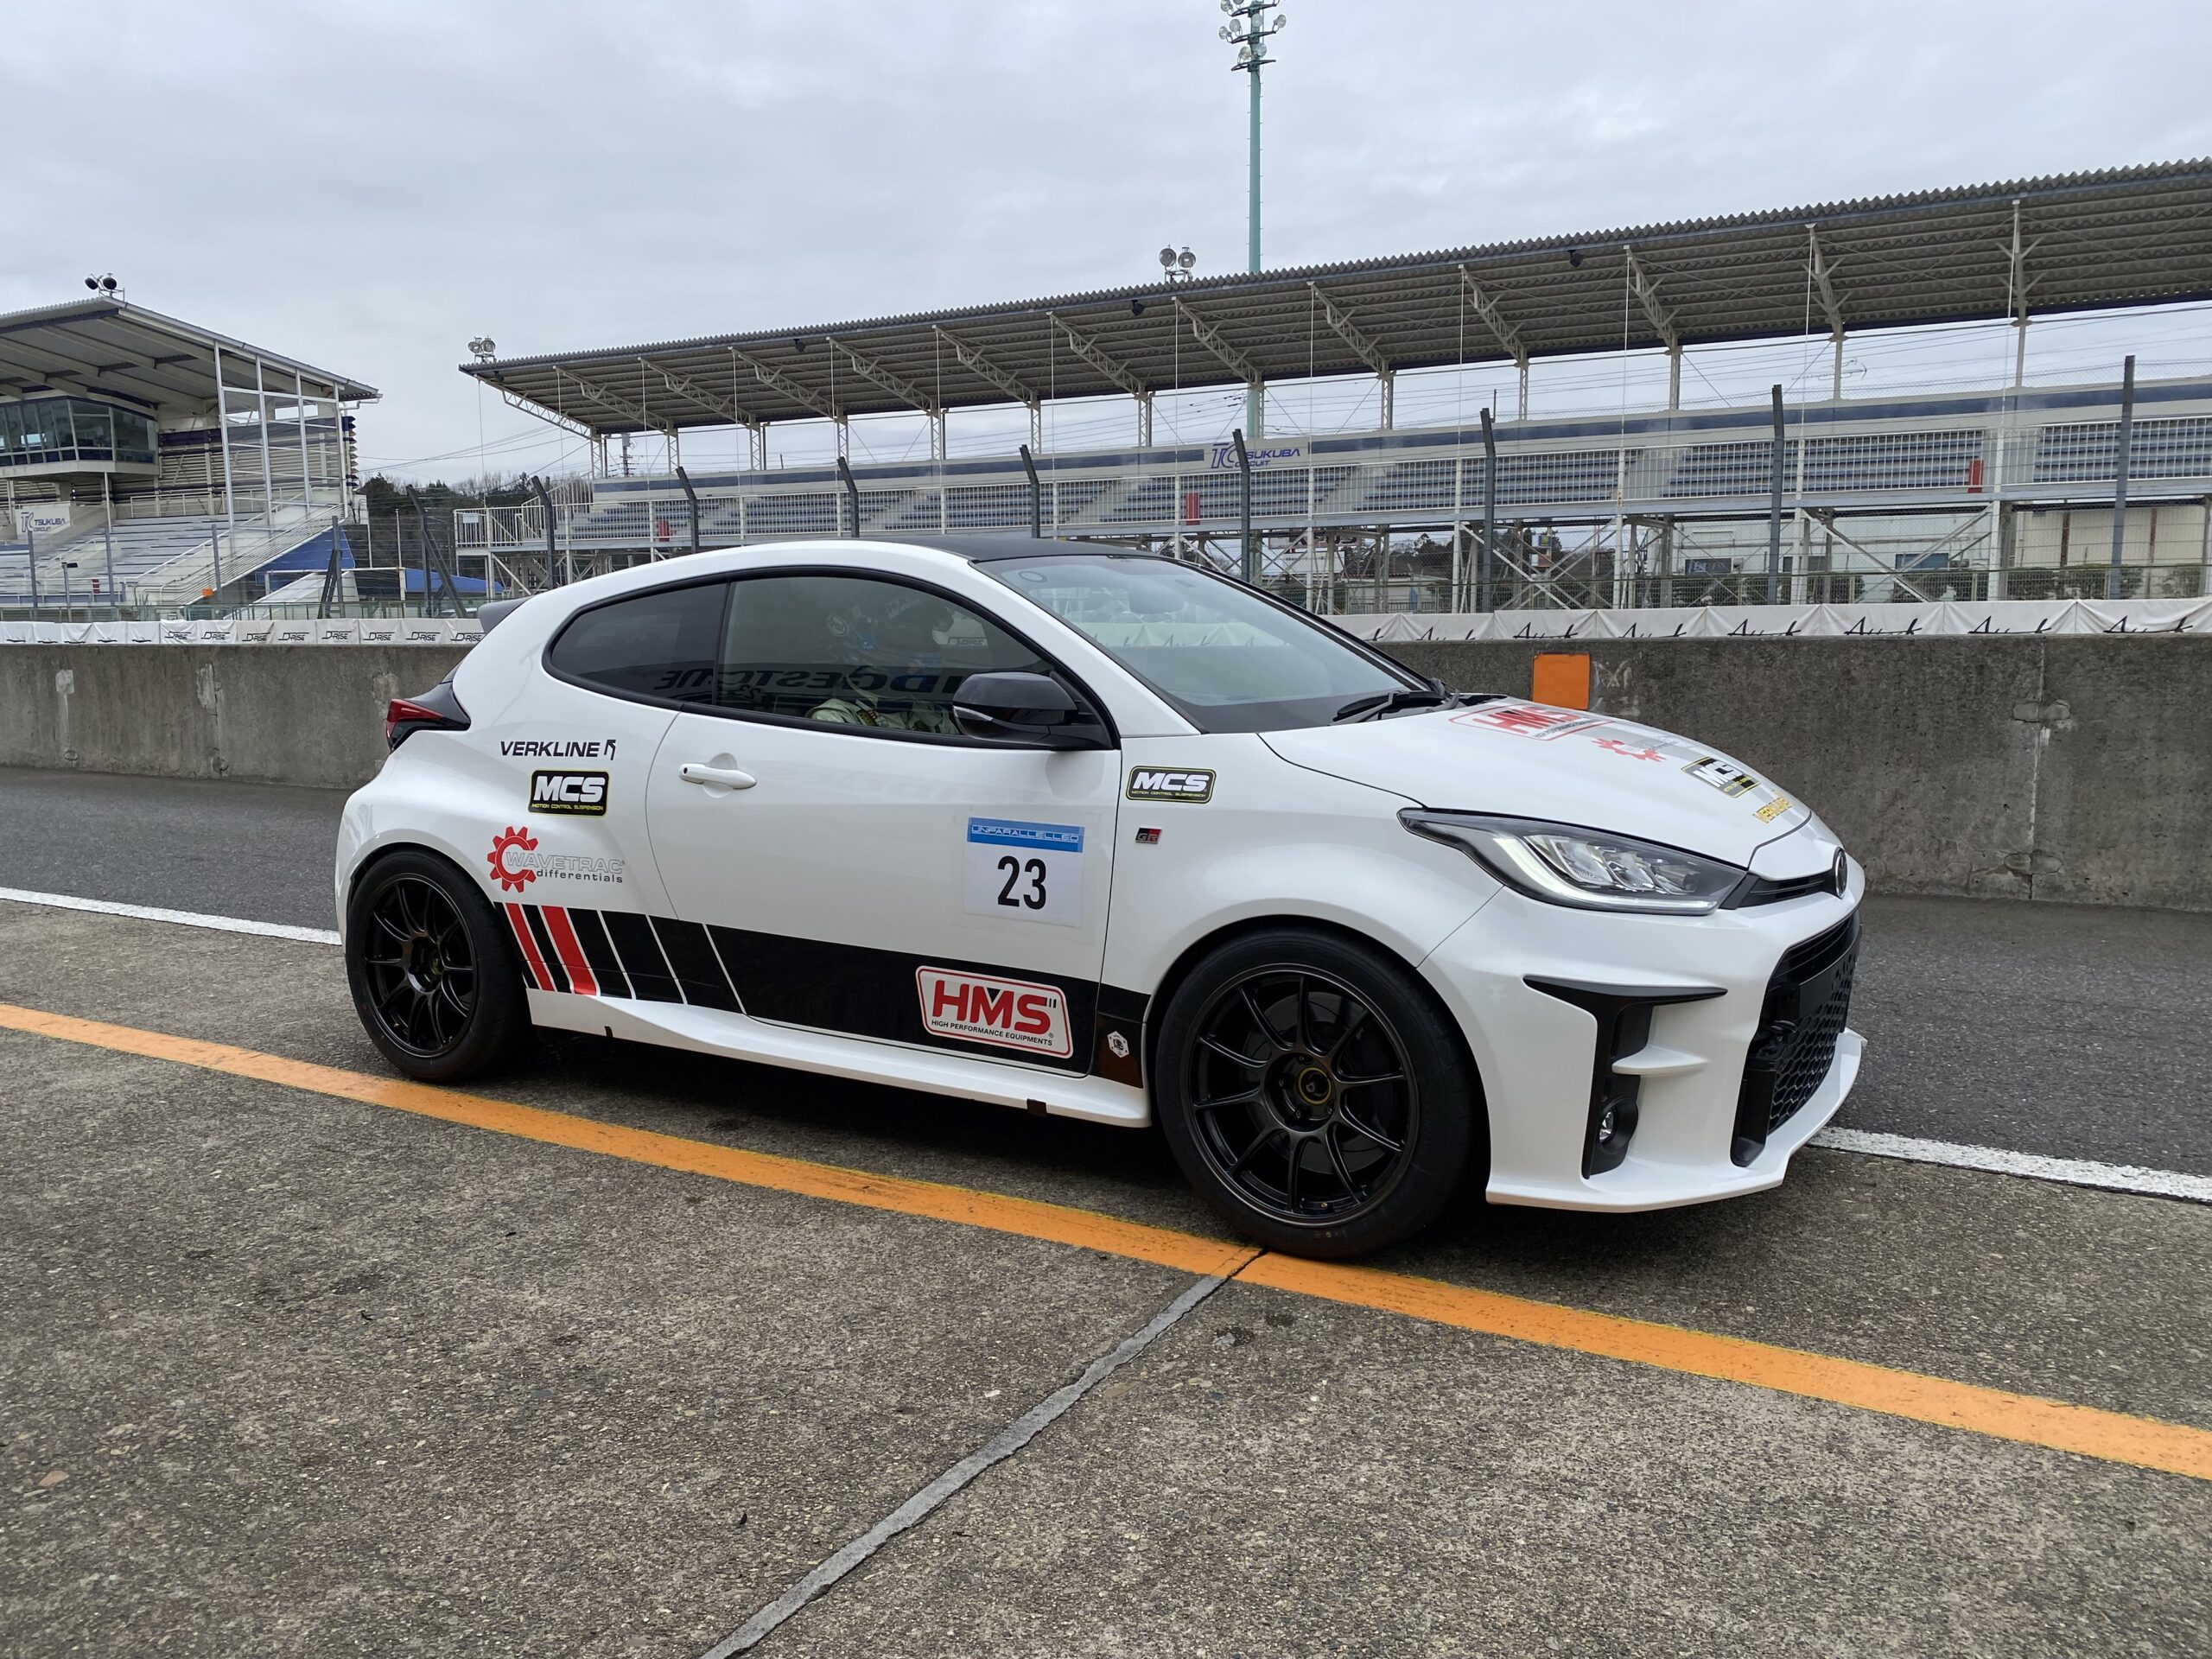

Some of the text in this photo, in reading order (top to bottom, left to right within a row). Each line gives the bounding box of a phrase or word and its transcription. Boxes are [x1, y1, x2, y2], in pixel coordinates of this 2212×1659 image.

[1245, 448, 1300, 459] SUKUBA
[34, 518, 66, 526] TSUKUBA
[499, 741, 600, 758] VERKLINE
[533, 775, 606, 803] MCS
[1132, 771, 1210, 792] MCS
[970, 824, 1079, 843] UNPARALLELLED
[1136, 832, 1160, 842] GR
[505, 851, 623, 874] WAVETRAC
[537, 868, 623, 883] differentials
[997, 855, 1047, 910] 23
[931, 979, 1052, 1035] HMS
[931, 1020, 1052, 1046] HIGH PERFORMANCE EQUIPMENTS
